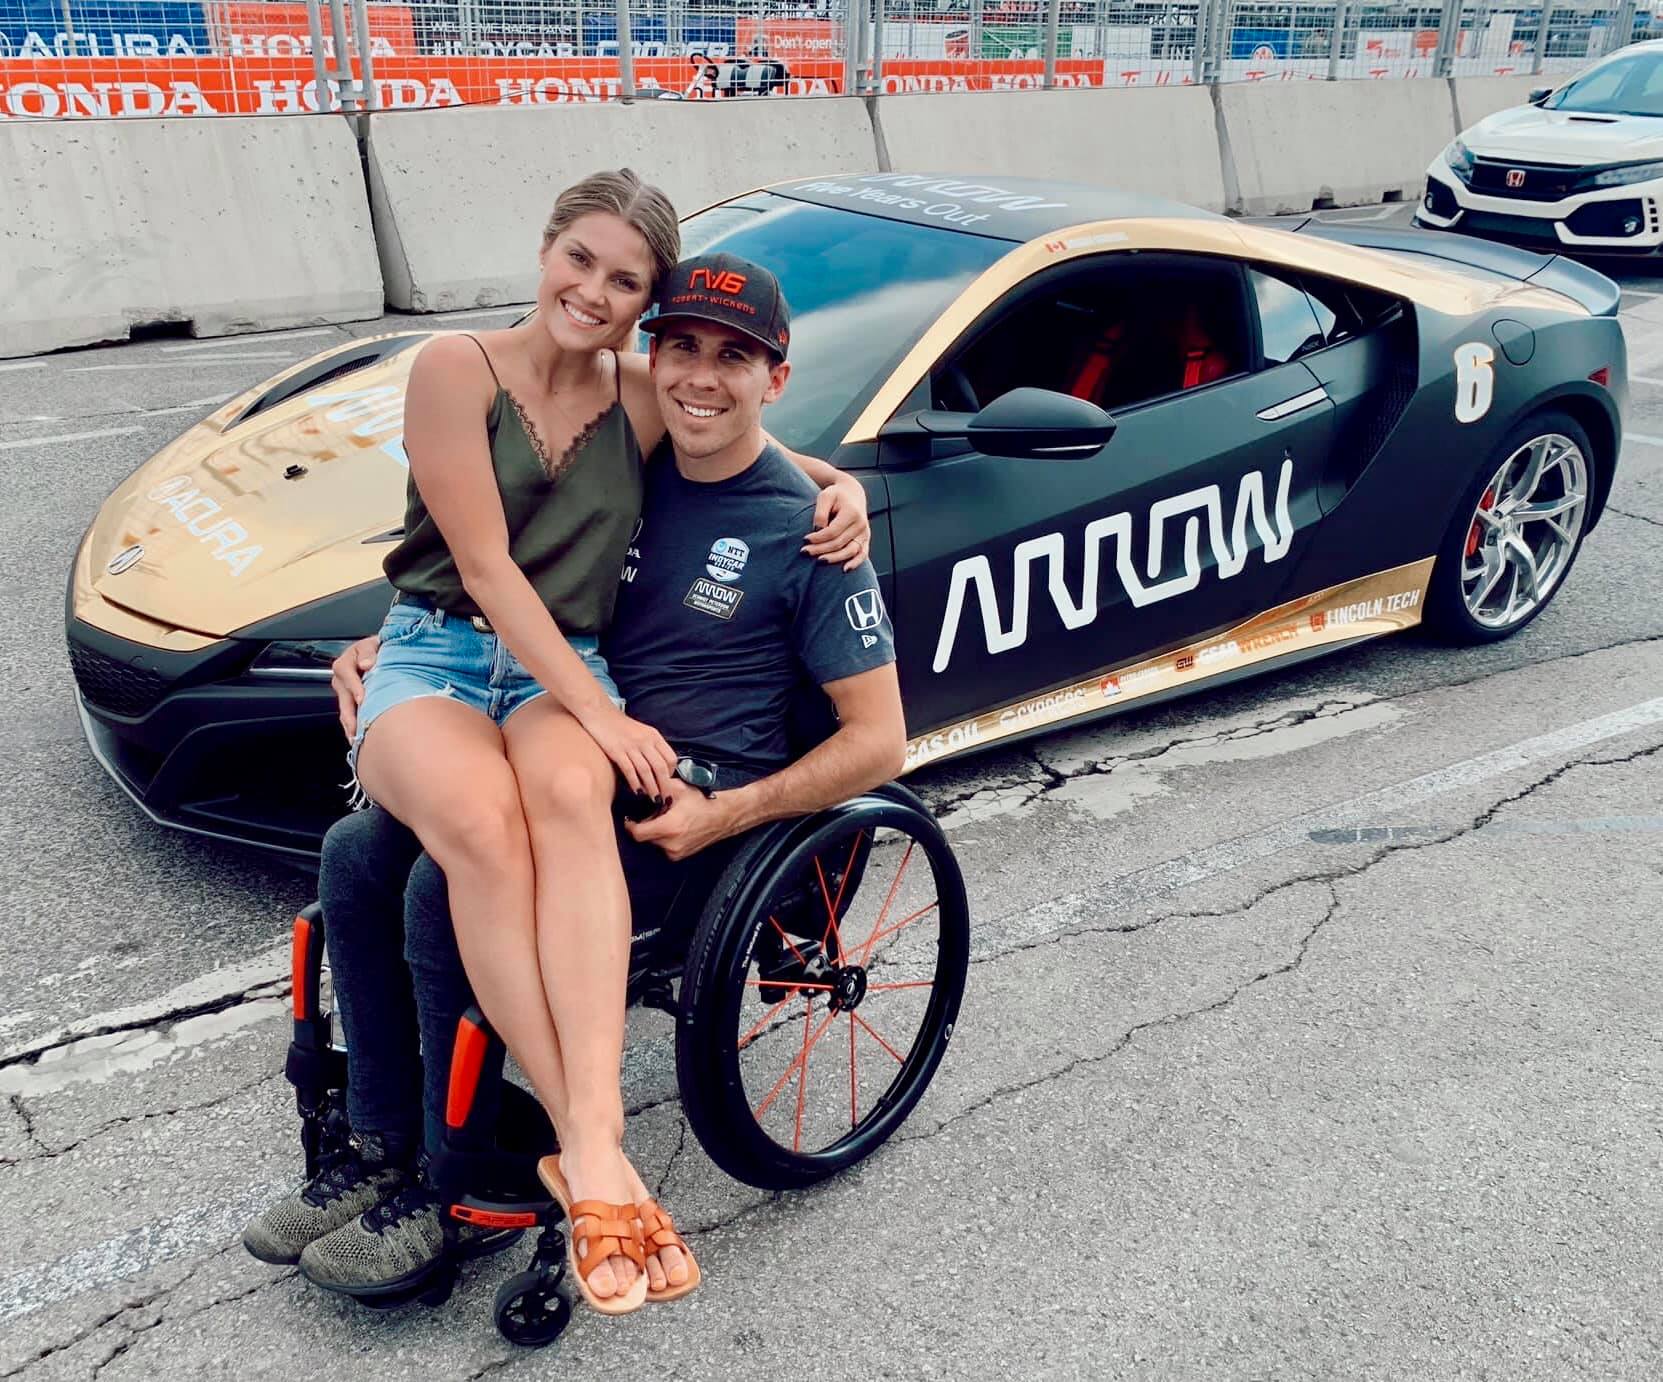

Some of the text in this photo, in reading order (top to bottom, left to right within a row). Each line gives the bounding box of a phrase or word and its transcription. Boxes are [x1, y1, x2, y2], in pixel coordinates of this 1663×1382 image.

[774, 35, 832, 52] Don't open
[0, 81, 217, 117] ONDA
[880, 74, 971, 94] ONDA
[794, 181, 992, 226] Five Years Out
[1454, 342, 1496, 424] 6
[160, 489, 264, 577] ACURA
[727, 545, 745, 557] NTT
[707, 553, 745, 571] INDYCAR
[932, 457, 1294, 674] ARROW
[1326, 589, 1421, 626] LINCOLN TECH
